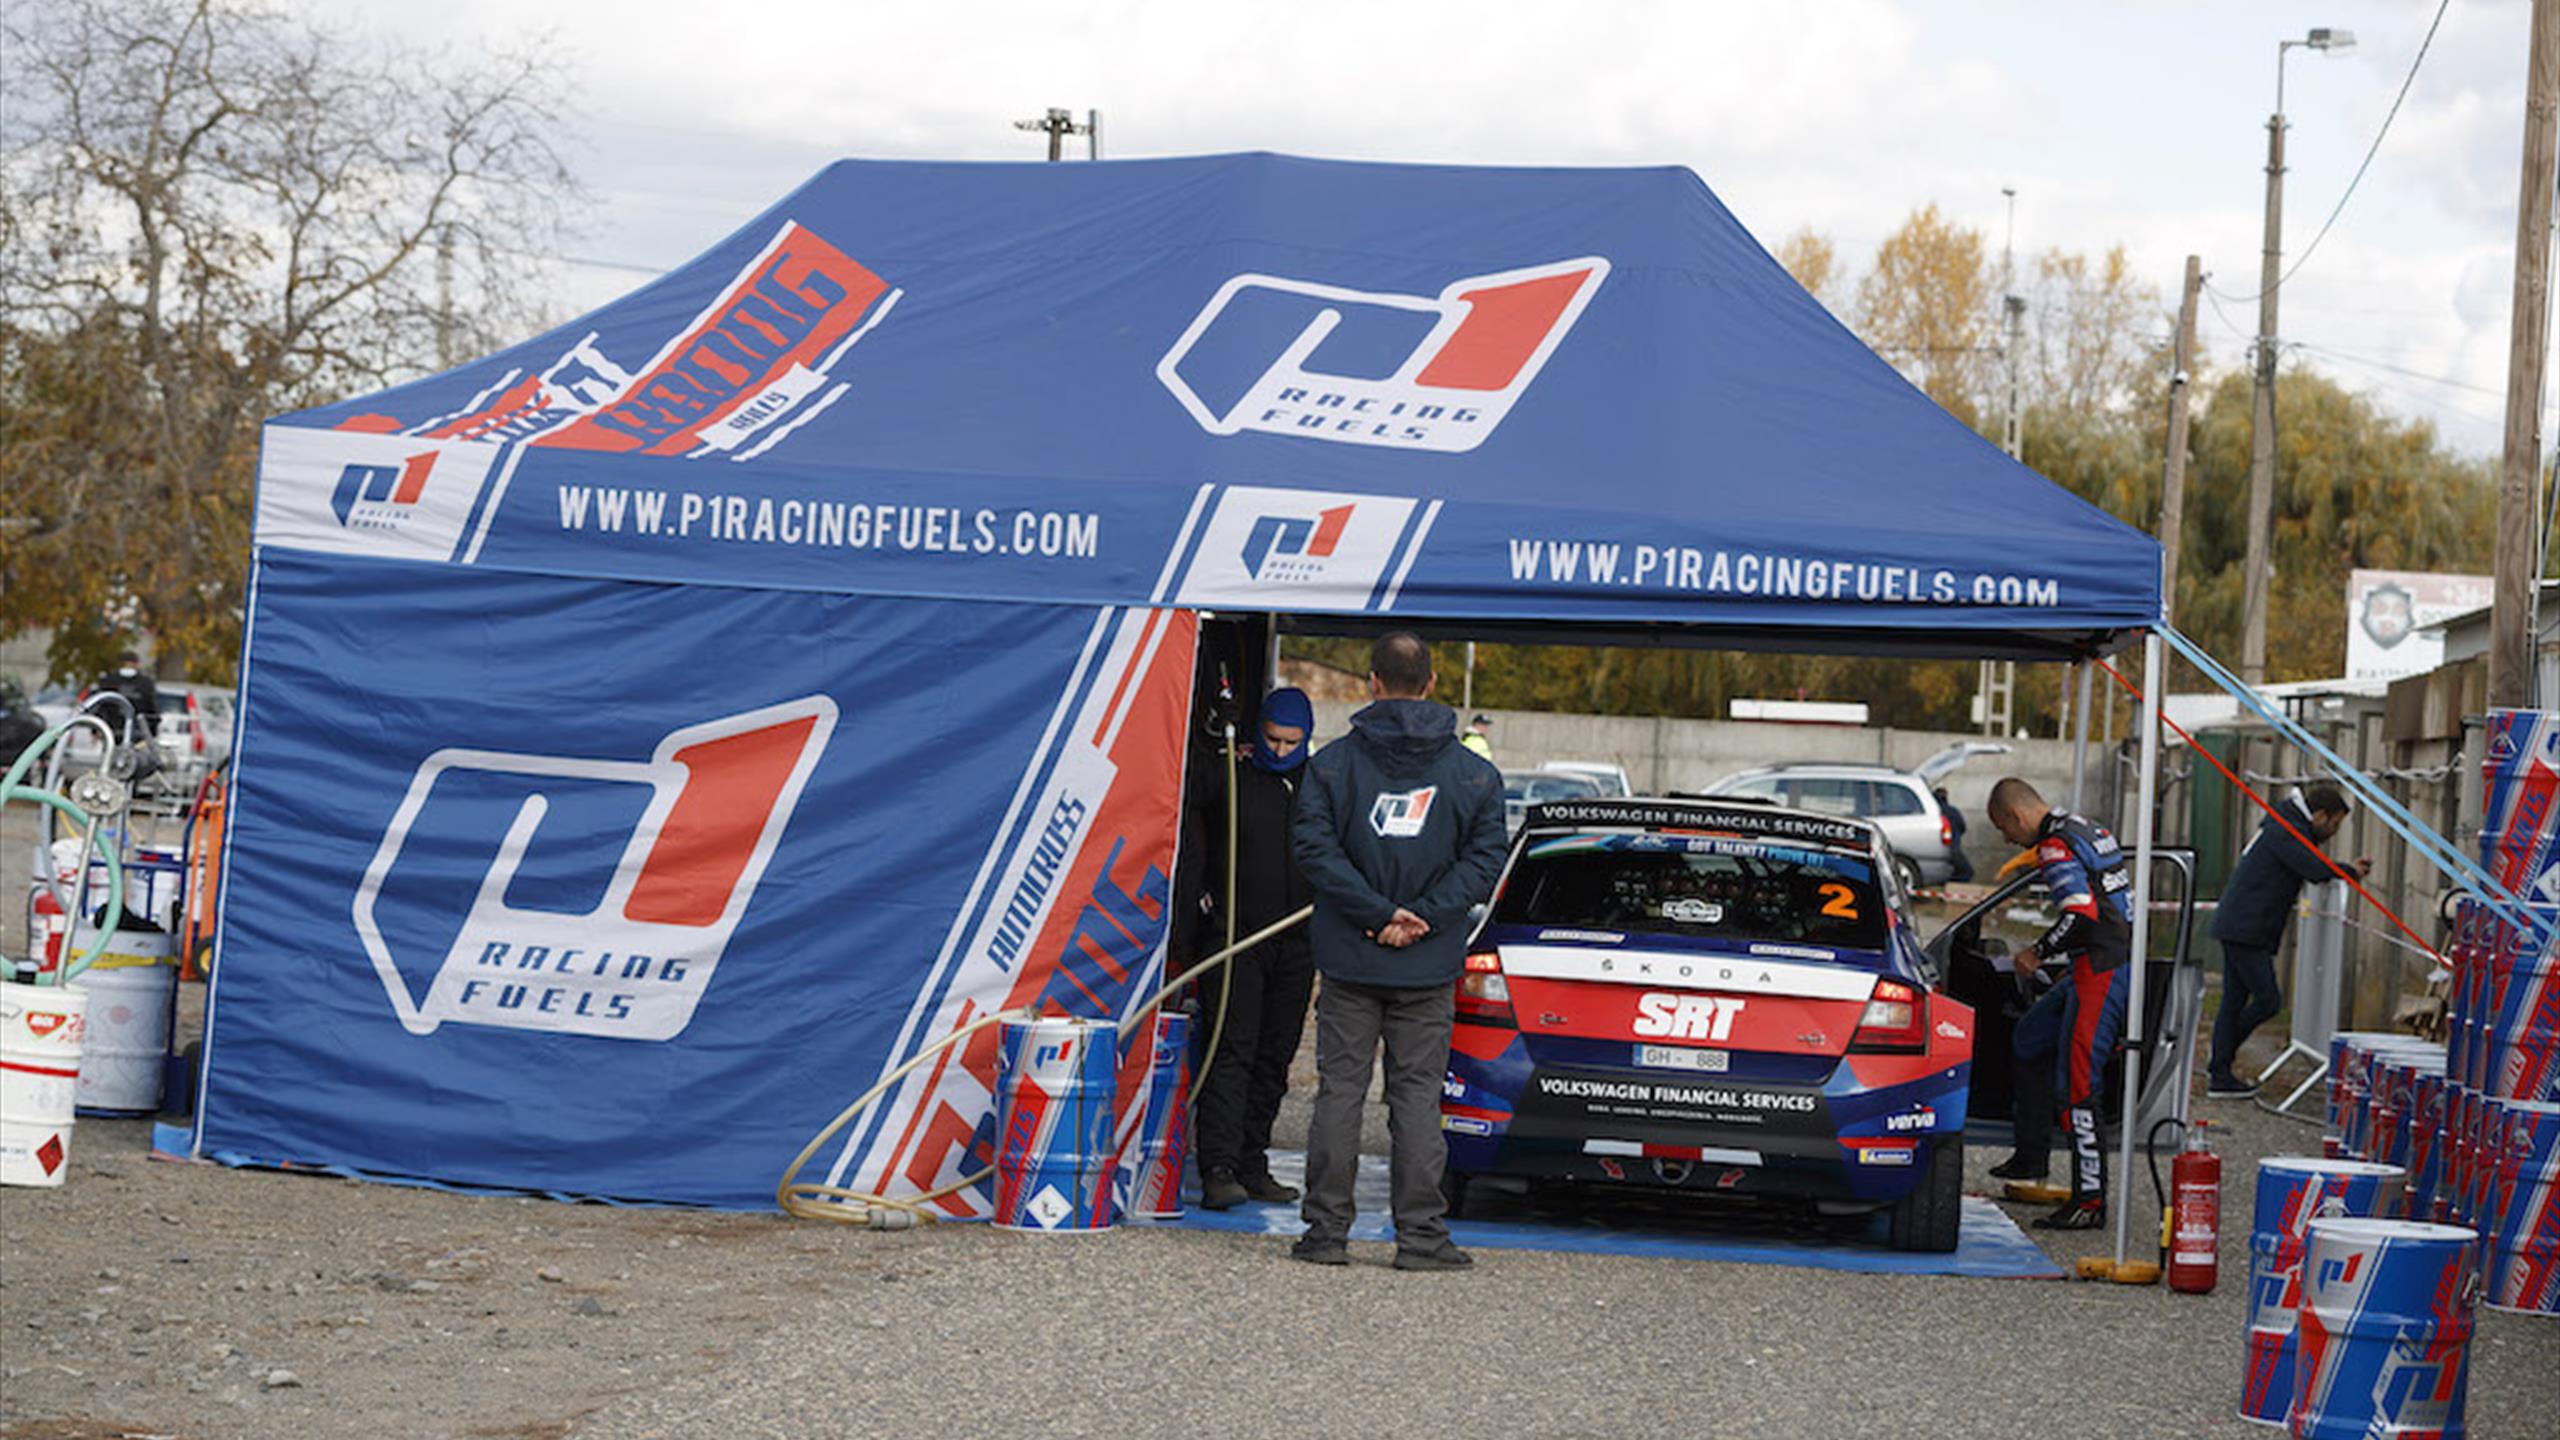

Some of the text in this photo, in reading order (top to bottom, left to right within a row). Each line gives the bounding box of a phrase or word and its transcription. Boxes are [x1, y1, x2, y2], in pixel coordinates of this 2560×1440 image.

[1260, 408, 1431, 441] FUELS
[1277, 386, 1482, 424] RACING
[559, 485, 1098, 558] WWW.P1RACINGFUELS.COM
[1509, 539, 2059, 607] WWW.P1RACINGFUELS.COM
[1541, 805, 1857, 840] VOLKSWAGEN FINANCIAL SERVICES
[987, 787, 1087, 973] AUTOCROSS
[1817, 882, 1859, 920] 2
[478, 941, 691, 983] RACING
[459, 979, 635, 1020] FUELS
[1633, 991, 1746, 1042] SRT
[1035, 1039, 1074, 1070] P1
[1695, 1051, 1727, 1069] 888
[1540, 1078, 1816, 1113] VOLKSWAGEN FINANCIAL SERVICES
[1887, 1112, 1936, 1131] verva
[2071, 1106, 2102, 1191] verva
[2317, 1252, 2364, 1294] P1
